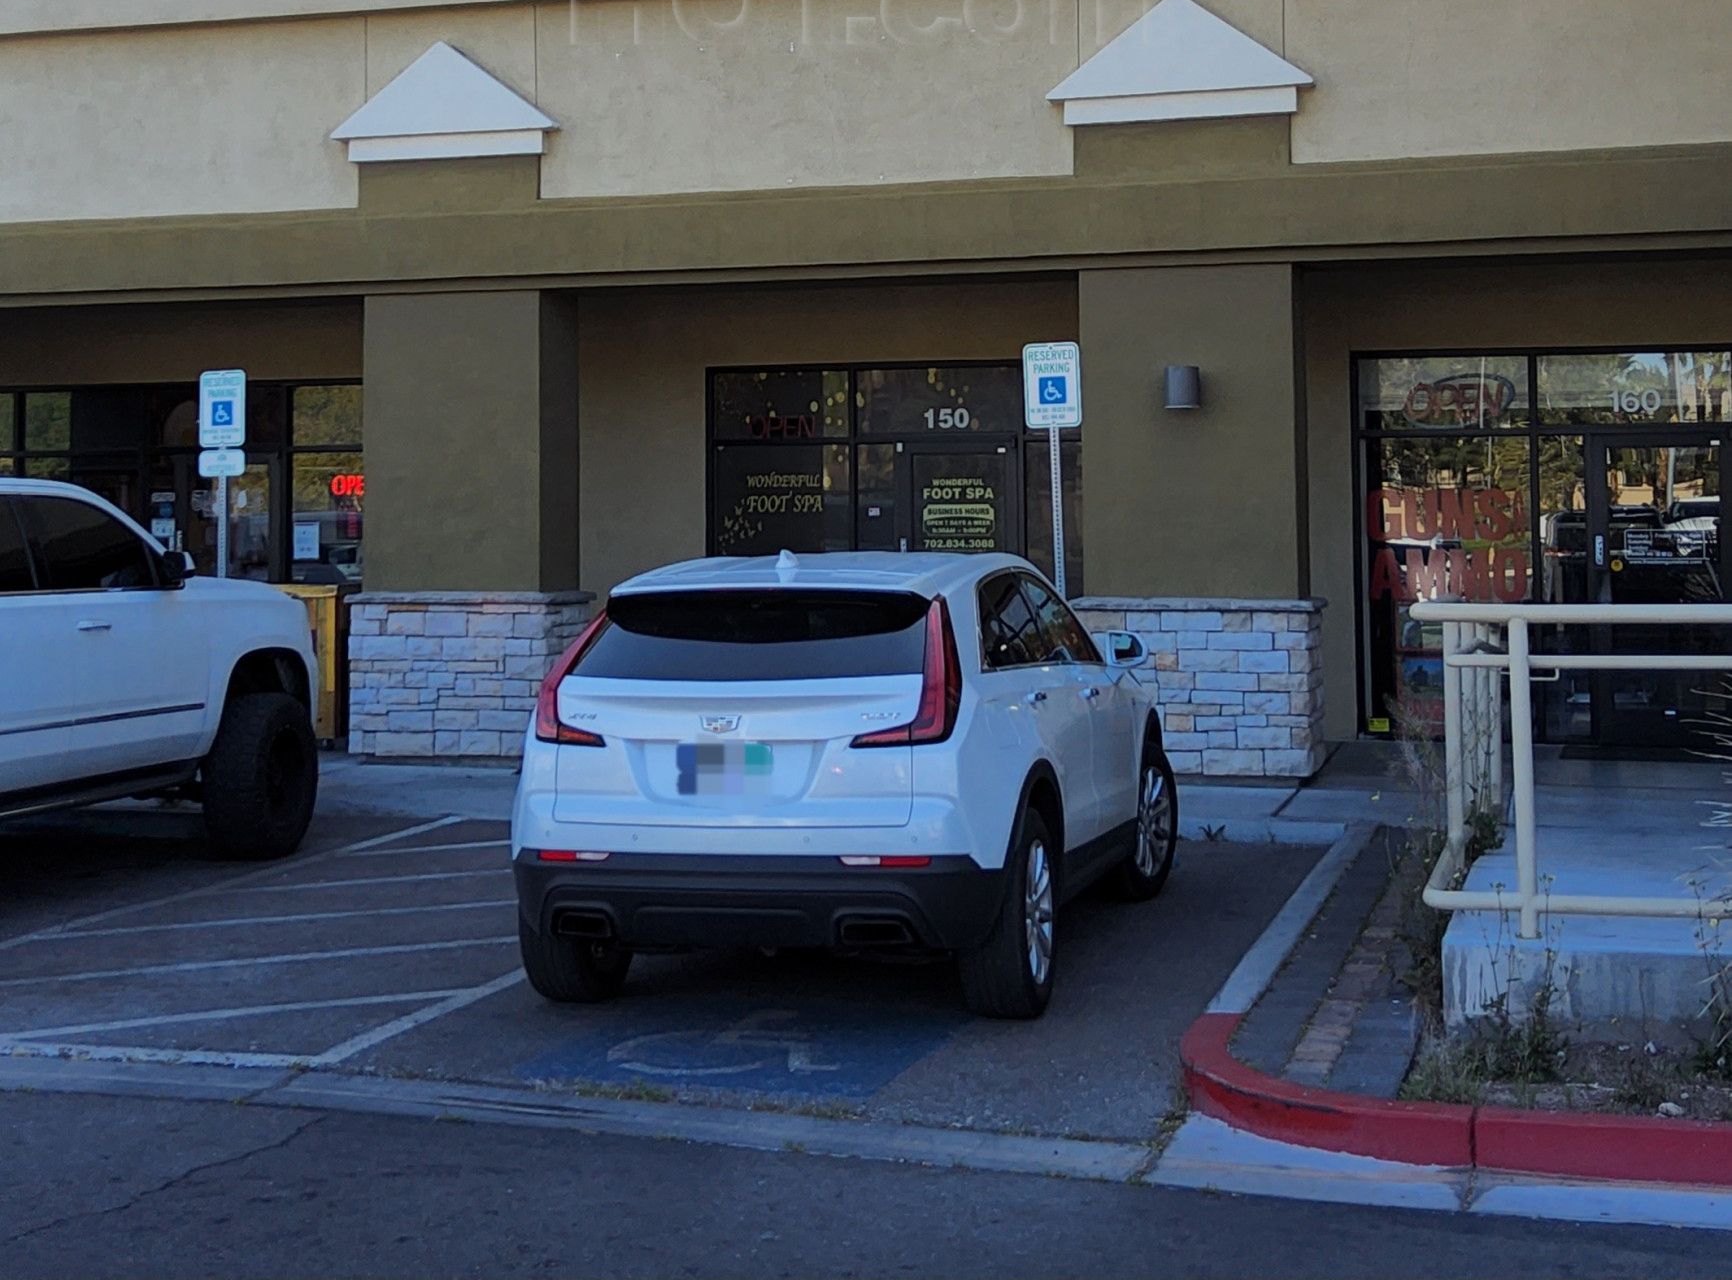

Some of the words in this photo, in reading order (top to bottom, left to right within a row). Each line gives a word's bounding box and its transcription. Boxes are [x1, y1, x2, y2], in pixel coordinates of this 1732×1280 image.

[1028, 349, 1074, 361] RESERVED
[1033, 362, 1070, 374] PARKING
[1406, 382, 1505, 422] OPEN
[1608, 387, 1661, 414] 160
[749, 414, 817, 439] OPEN
[923, 407, 970, 429] 150
[747, 472, 820, 488] WONDERFUL
[932, 478, 983, 486] WONDERFUL
[746, 490, 793, 513] FOOT
[793, 495, 823, 513] SPA
[923, 488, 962, 499] FOOT
[965, 487, 994, 499] SPA
[927, 508, 963, 516] BUSINESS
[1367, 488, 1509, 541] GUNS
[1370, 547, 1529, 602] AMMO
